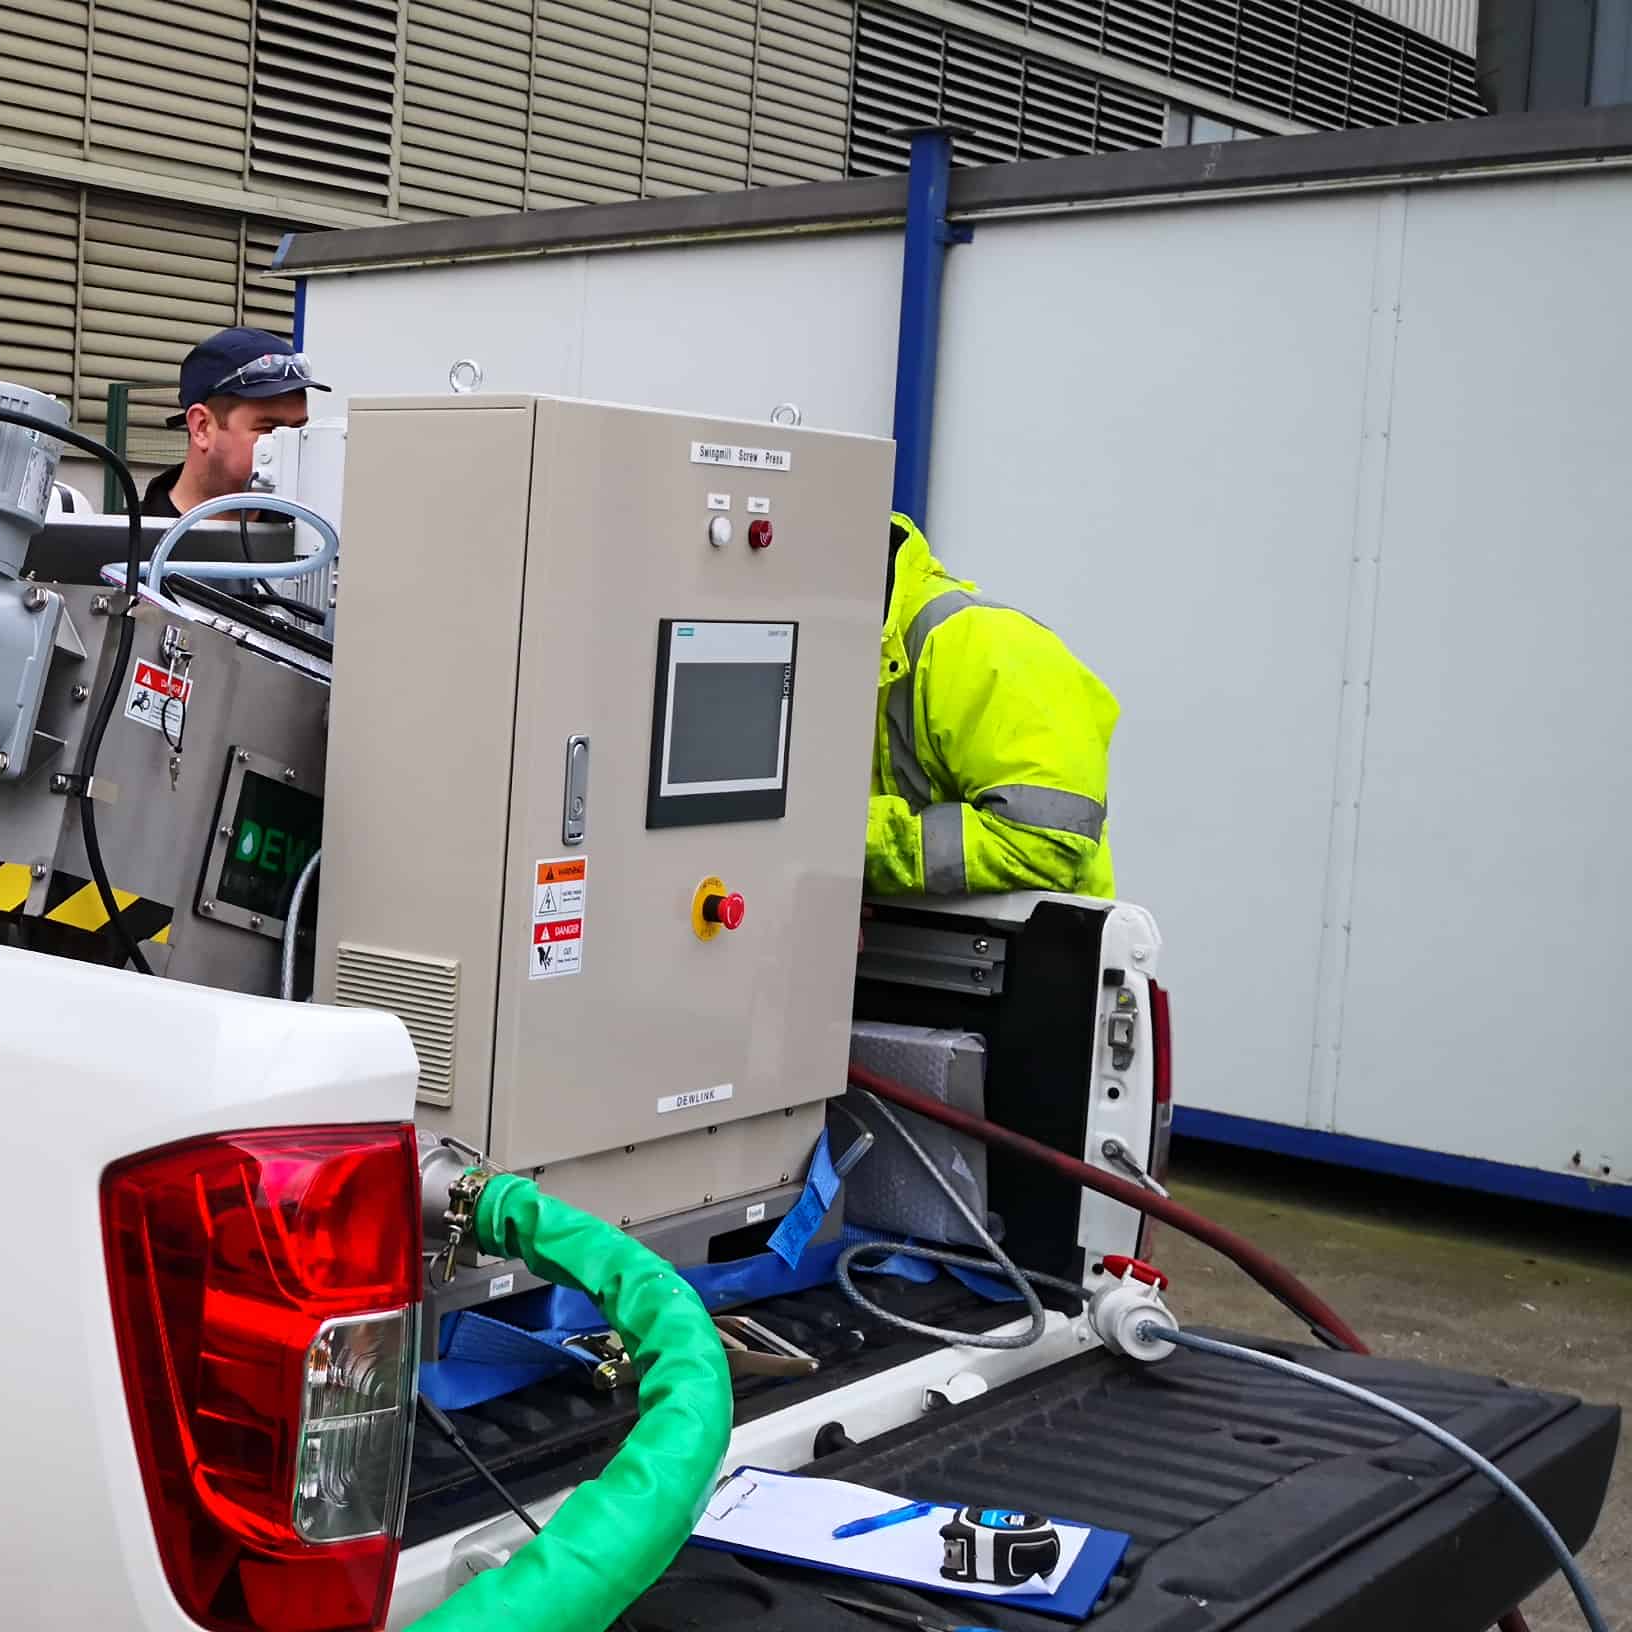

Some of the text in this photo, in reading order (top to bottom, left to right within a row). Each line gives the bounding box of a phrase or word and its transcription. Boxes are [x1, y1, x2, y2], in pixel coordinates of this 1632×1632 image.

[699, 445, 732, 462] Swingmill
[738, 448, 758, 463] Screw
[554, 924, 579, 936] DANGER
[676, 1090, 715, 1107] DEWLINK
